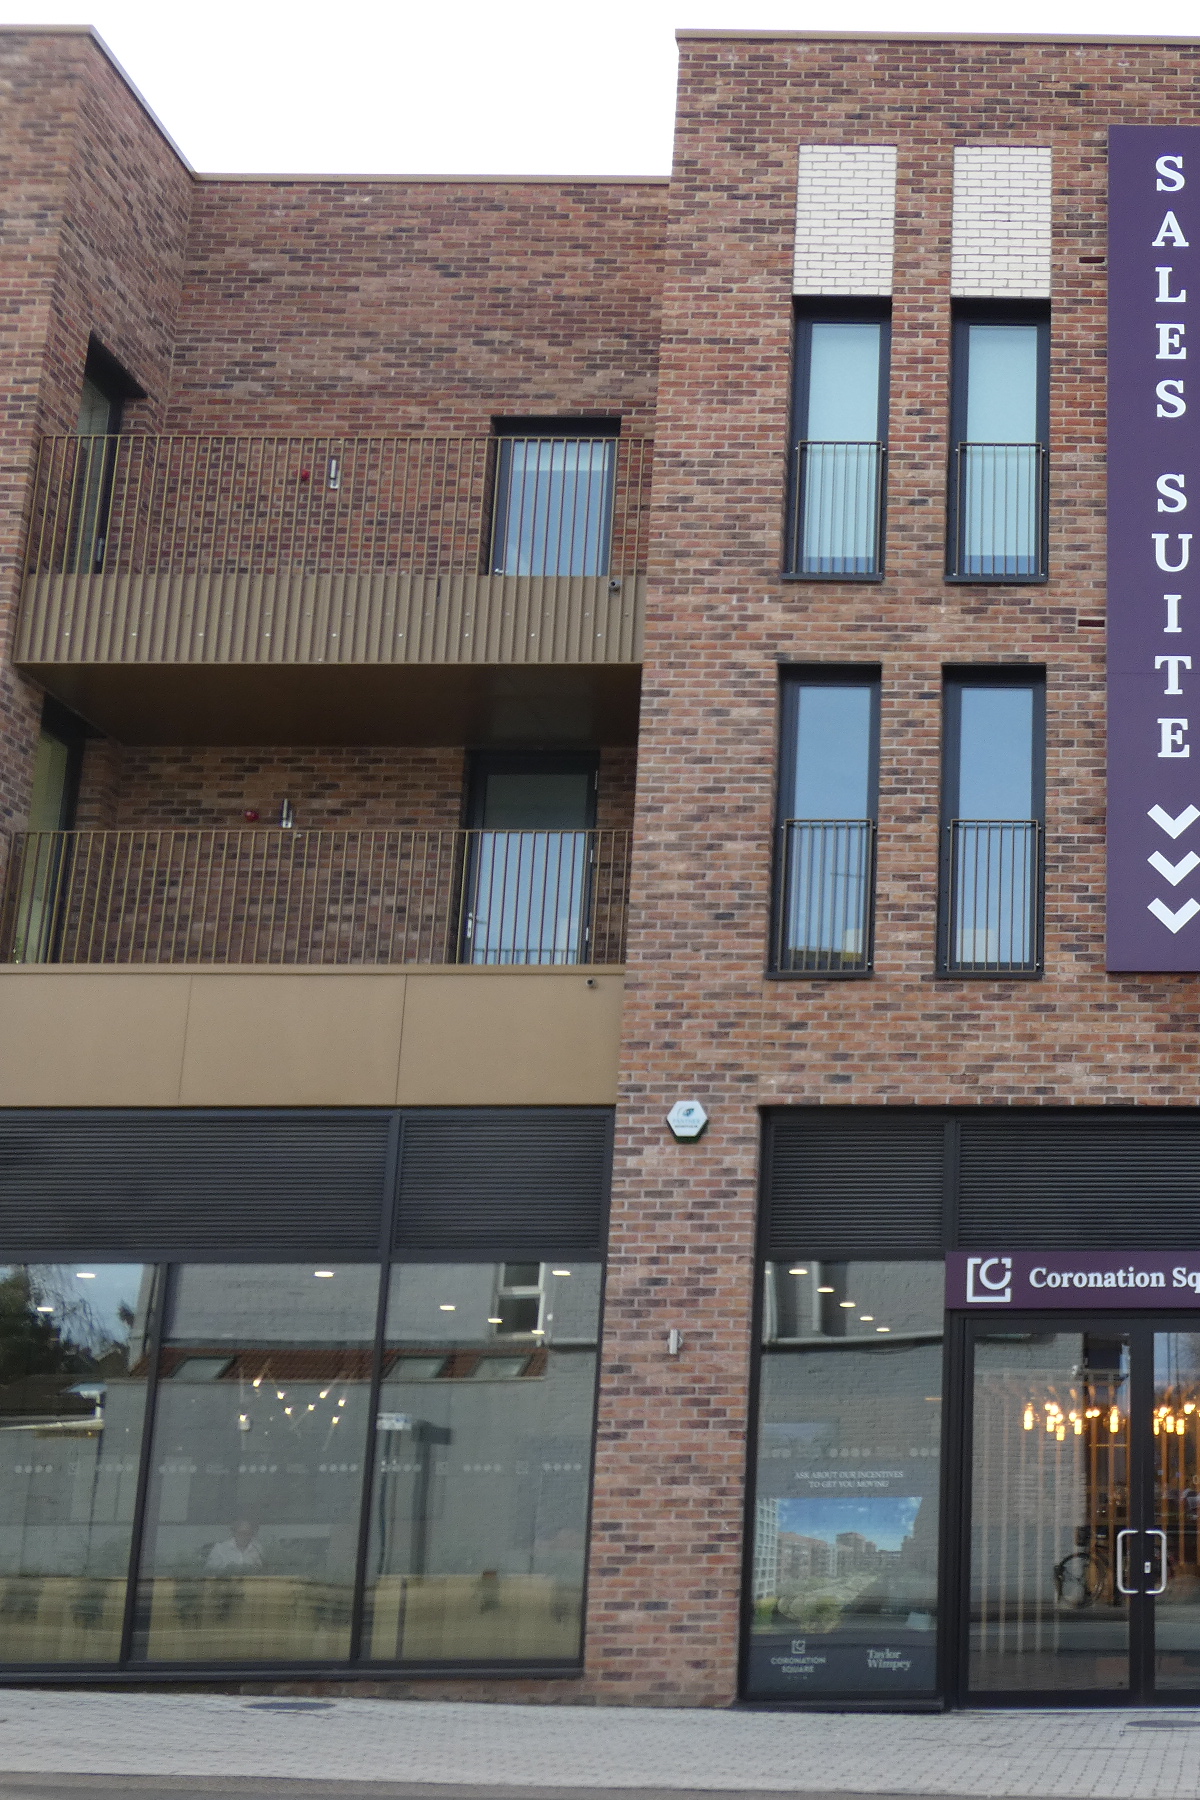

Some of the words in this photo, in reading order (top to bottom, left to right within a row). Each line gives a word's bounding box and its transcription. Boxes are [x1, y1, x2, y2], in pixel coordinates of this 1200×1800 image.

[1151, 155, 1189, 418] SALES
[1151, 473, 1193, 758] SUITE
[1029, 1267, 1166, 1288] Coronation
[795, 1471, 810, 1479] ASK
[812, 1471, 838, 1479] ABOUT
[857, 1470, 904, 1479] INCENTIVES
[867, 1649, 902, 1659] Taylor
[770, 1656, 827, 1665] CORONATION
[867, 1659, 911, 1671] Wimpey
